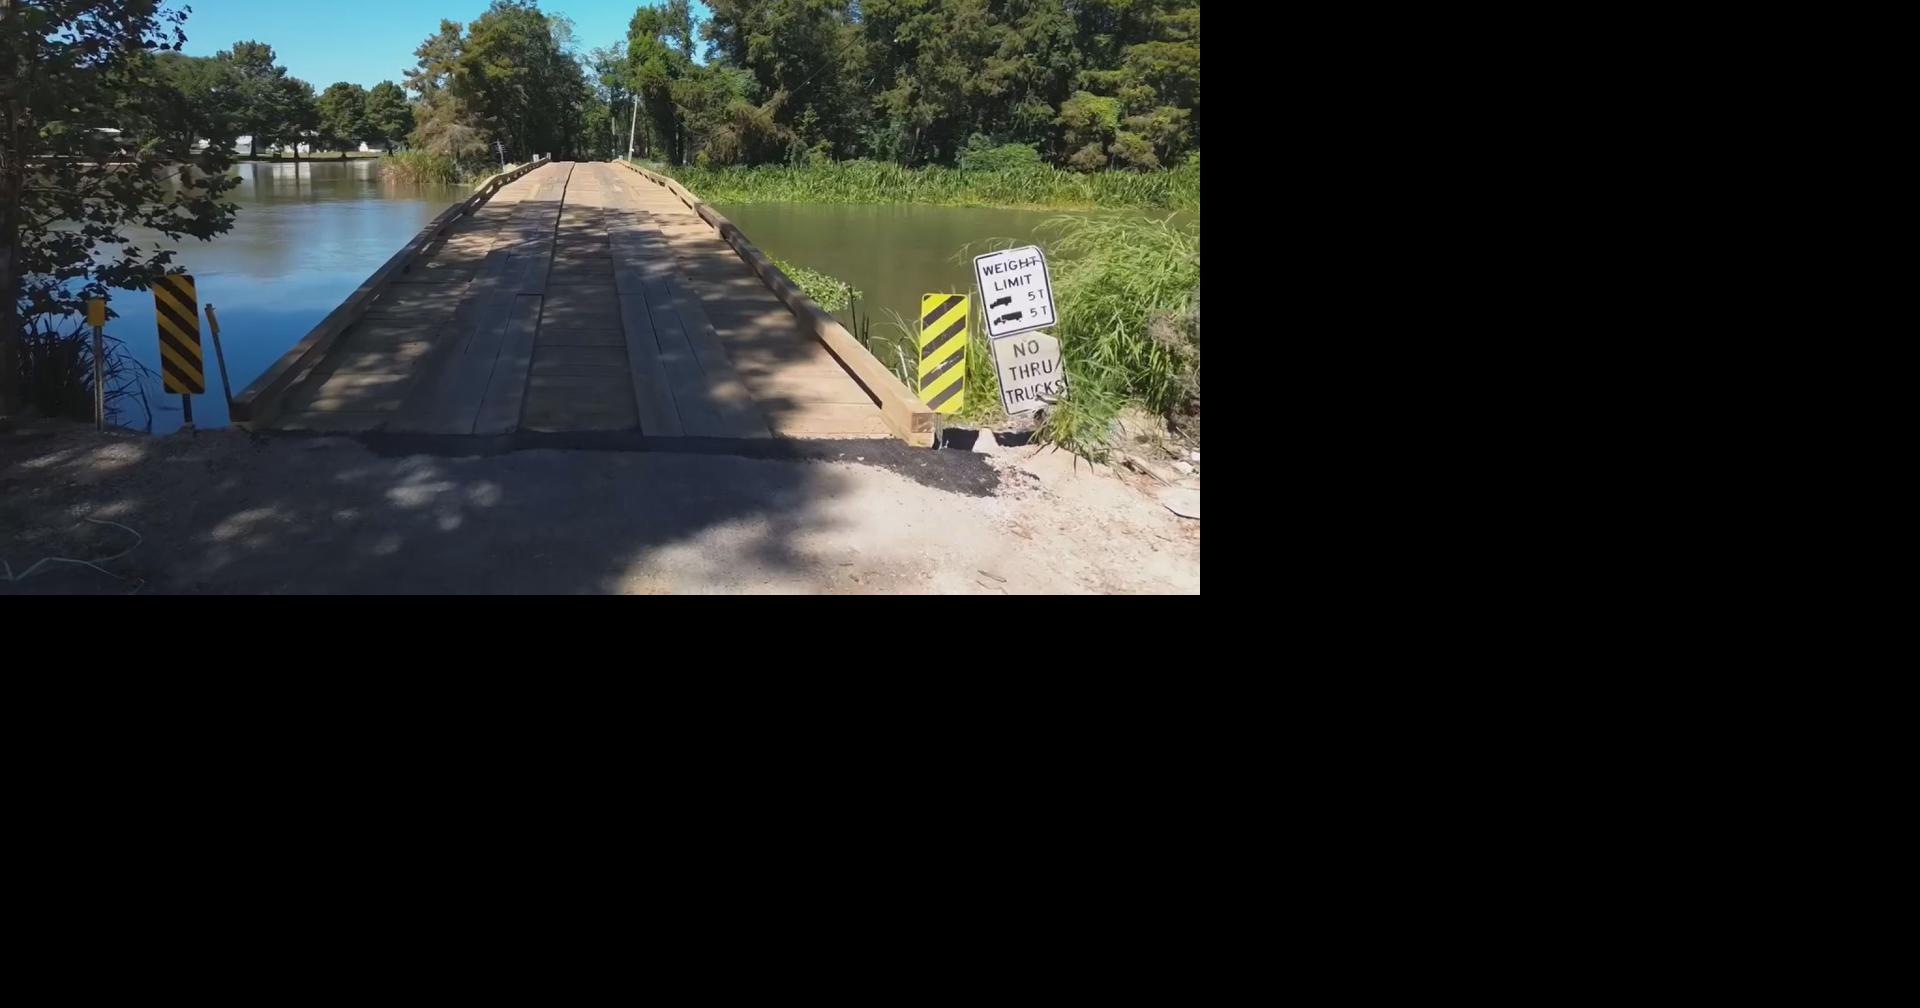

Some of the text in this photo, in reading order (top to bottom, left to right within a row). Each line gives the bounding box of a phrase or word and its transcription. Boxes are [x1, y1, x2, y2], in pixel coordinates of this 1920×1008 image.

[983, 256, 1037, 276] WEIGHT
[994, 274, 1032, 291] LIMIT
[1013, 340, 1040, 358] NO
[1009, 359, 1053, 381] THRU
[1005, 379, 1065, 405] TRUCKS
